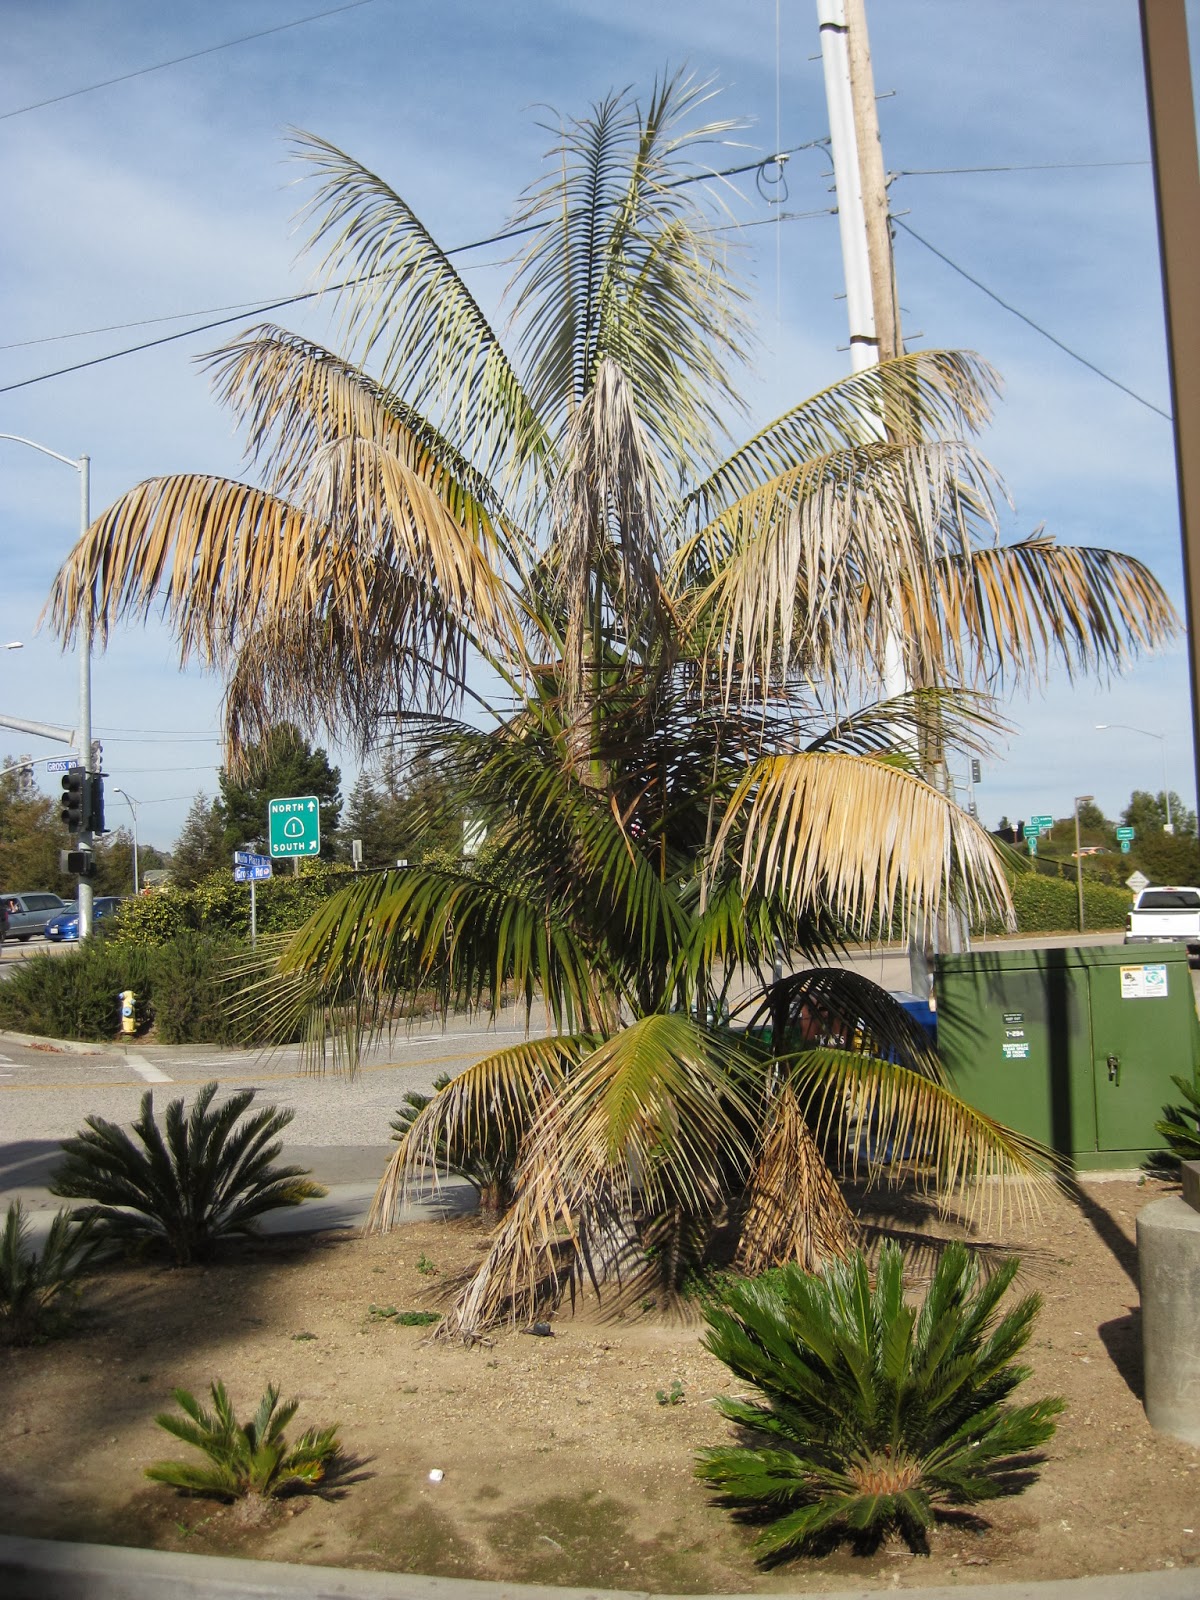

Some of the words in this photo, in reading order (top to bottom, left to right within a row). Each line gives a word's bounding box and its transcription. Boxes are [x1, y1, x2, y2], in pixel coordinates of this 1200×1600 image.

[48, 762, 66, 770] GROSS
[272, 803, 304, 813] NORTH
[292, 823, 296, 833] 1
[274, 842, 305, 852] SOUTH
[236, 869, 253, 878] Gross
[256, 868, 263, 877] Rd
